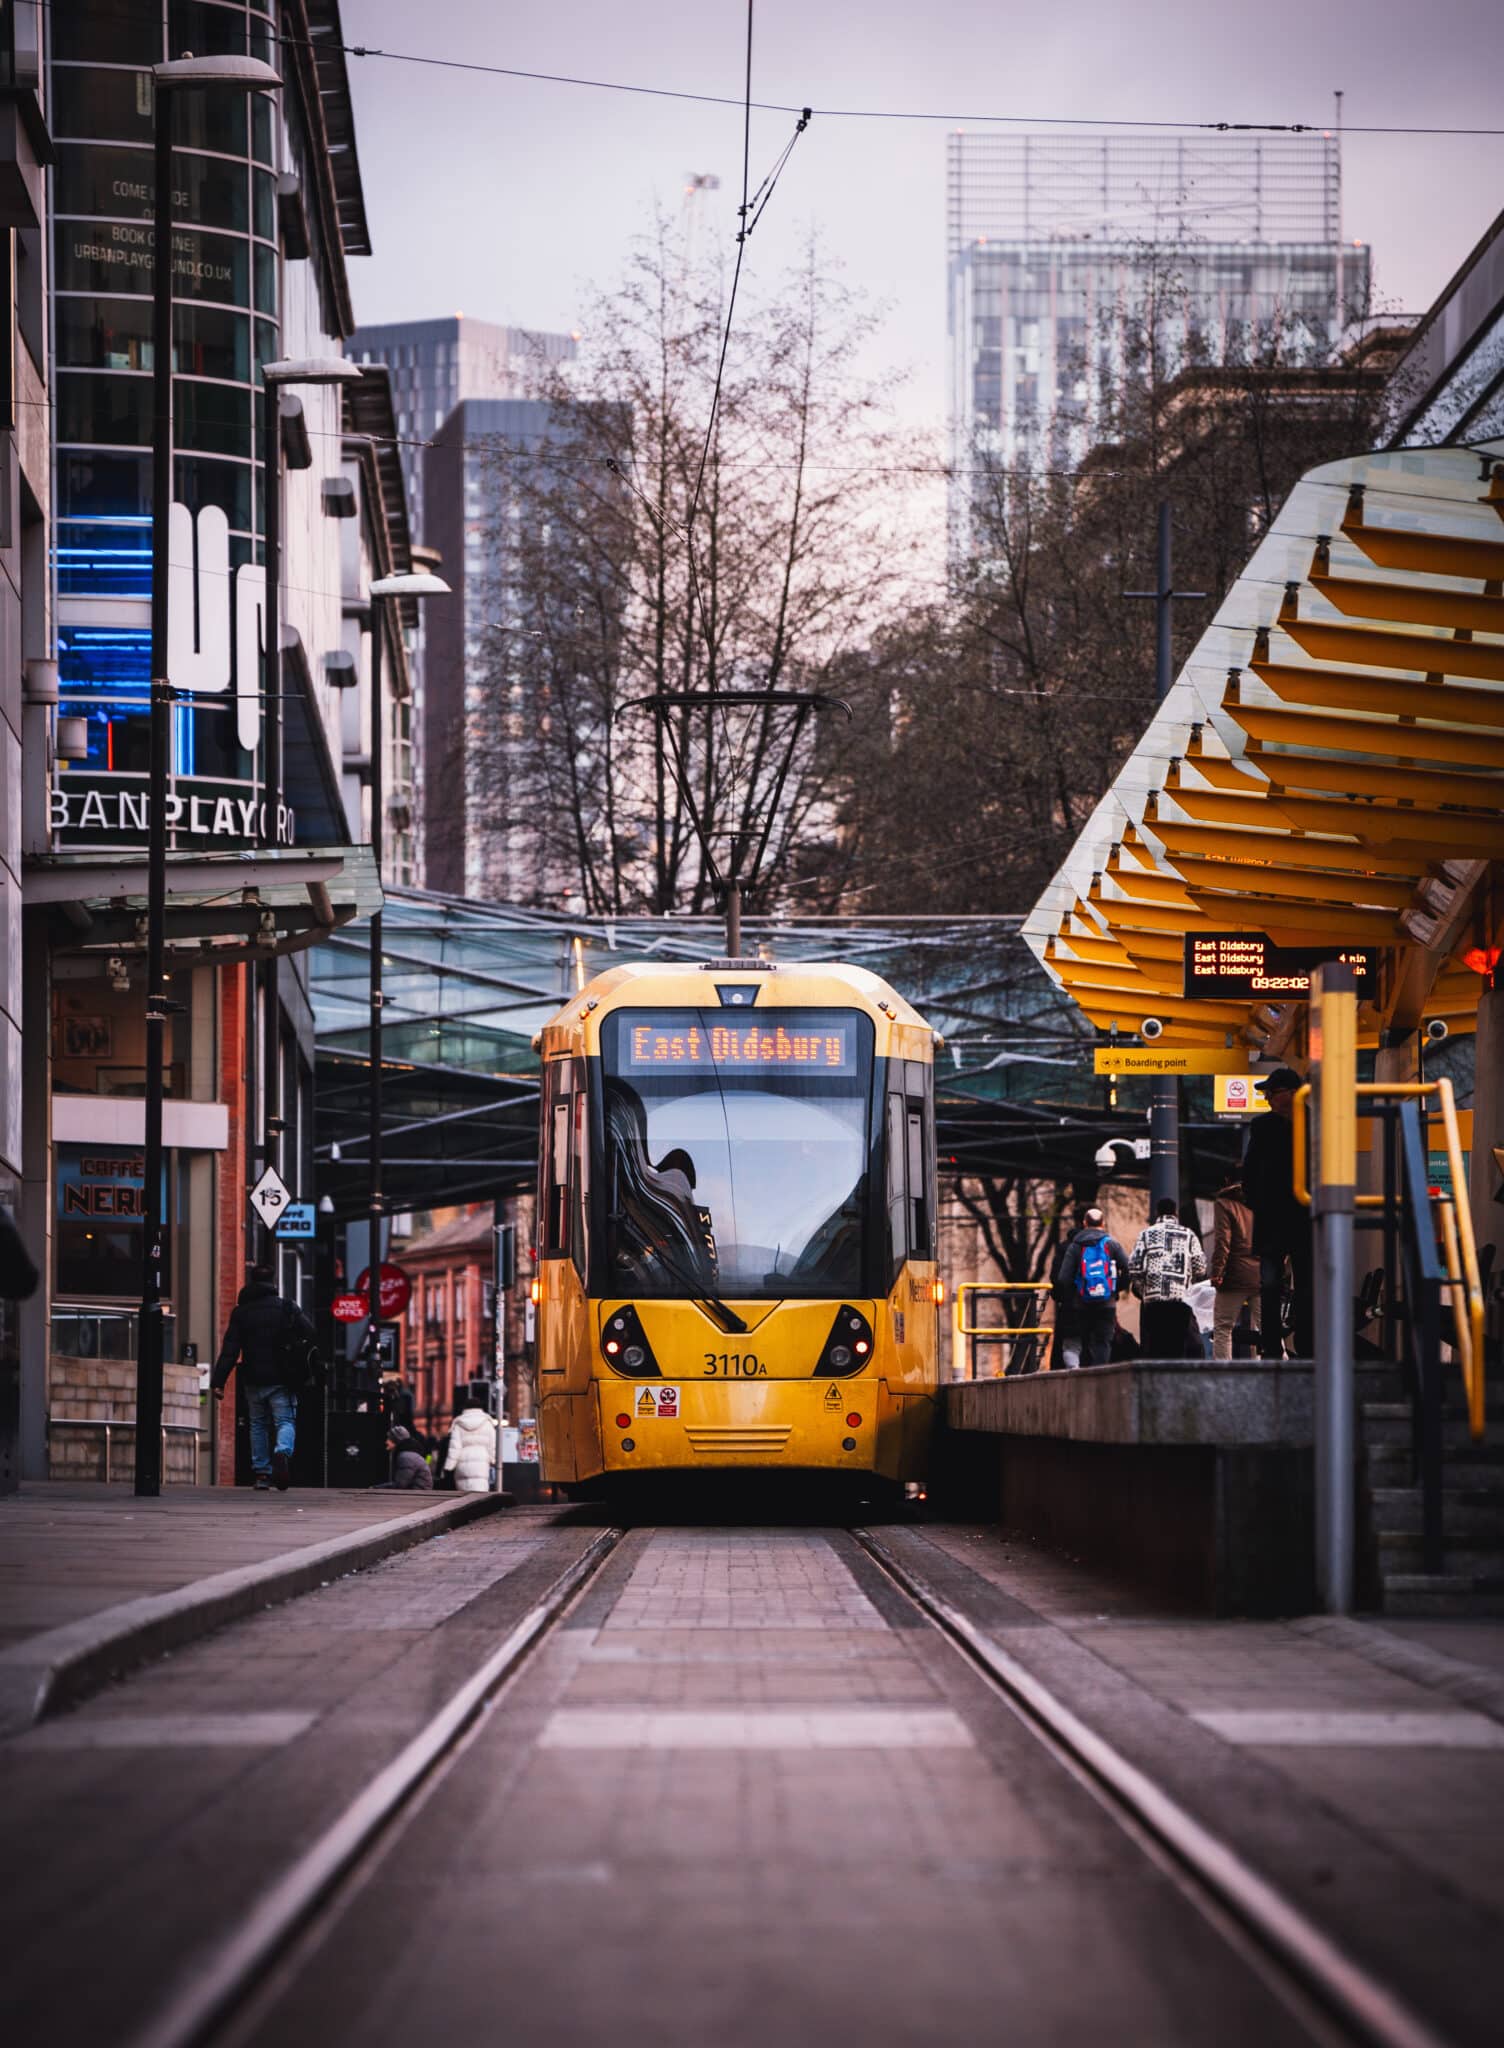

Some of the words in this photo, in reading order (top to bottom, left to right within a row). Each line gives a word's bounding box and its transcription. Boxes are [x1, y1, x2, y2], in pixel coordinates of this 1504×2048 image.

[112, 180, 148, 200] COME
[112, 226, 145, 245] BOOK
[1194, 941, 1217, 952] East
[1219, 940, 1264, 953] Didsbury
[1194, 953, 1217, 964] East
[1219, 952, 1264, 964] Didsbury
[1339, 953, 1346, 963] 4
[1194, 965, 1217, 976] East
[1219, 964, 1264, 976] Didsbury
[1353, 966, 1367, 976] in
[1252, 977, 1310, 989] 09:22:02
[635, 1026, 701, 1060] East
[711, 1026, 841, 1066] Didsbury
[1125, 1058, 1163, 1070] Boarding
[1164, 1058, 1187, 1069] point
[64, 1183, 146, 1216] NER
[259, 1189, 281, 1207] 15
[277, 1220, 311, 1231] ERO
[338, 1299, 361, 1308] POST
[333, 1307, 364, 1318] OFFICE
[703, 1353, 769, 1377] 3110A
